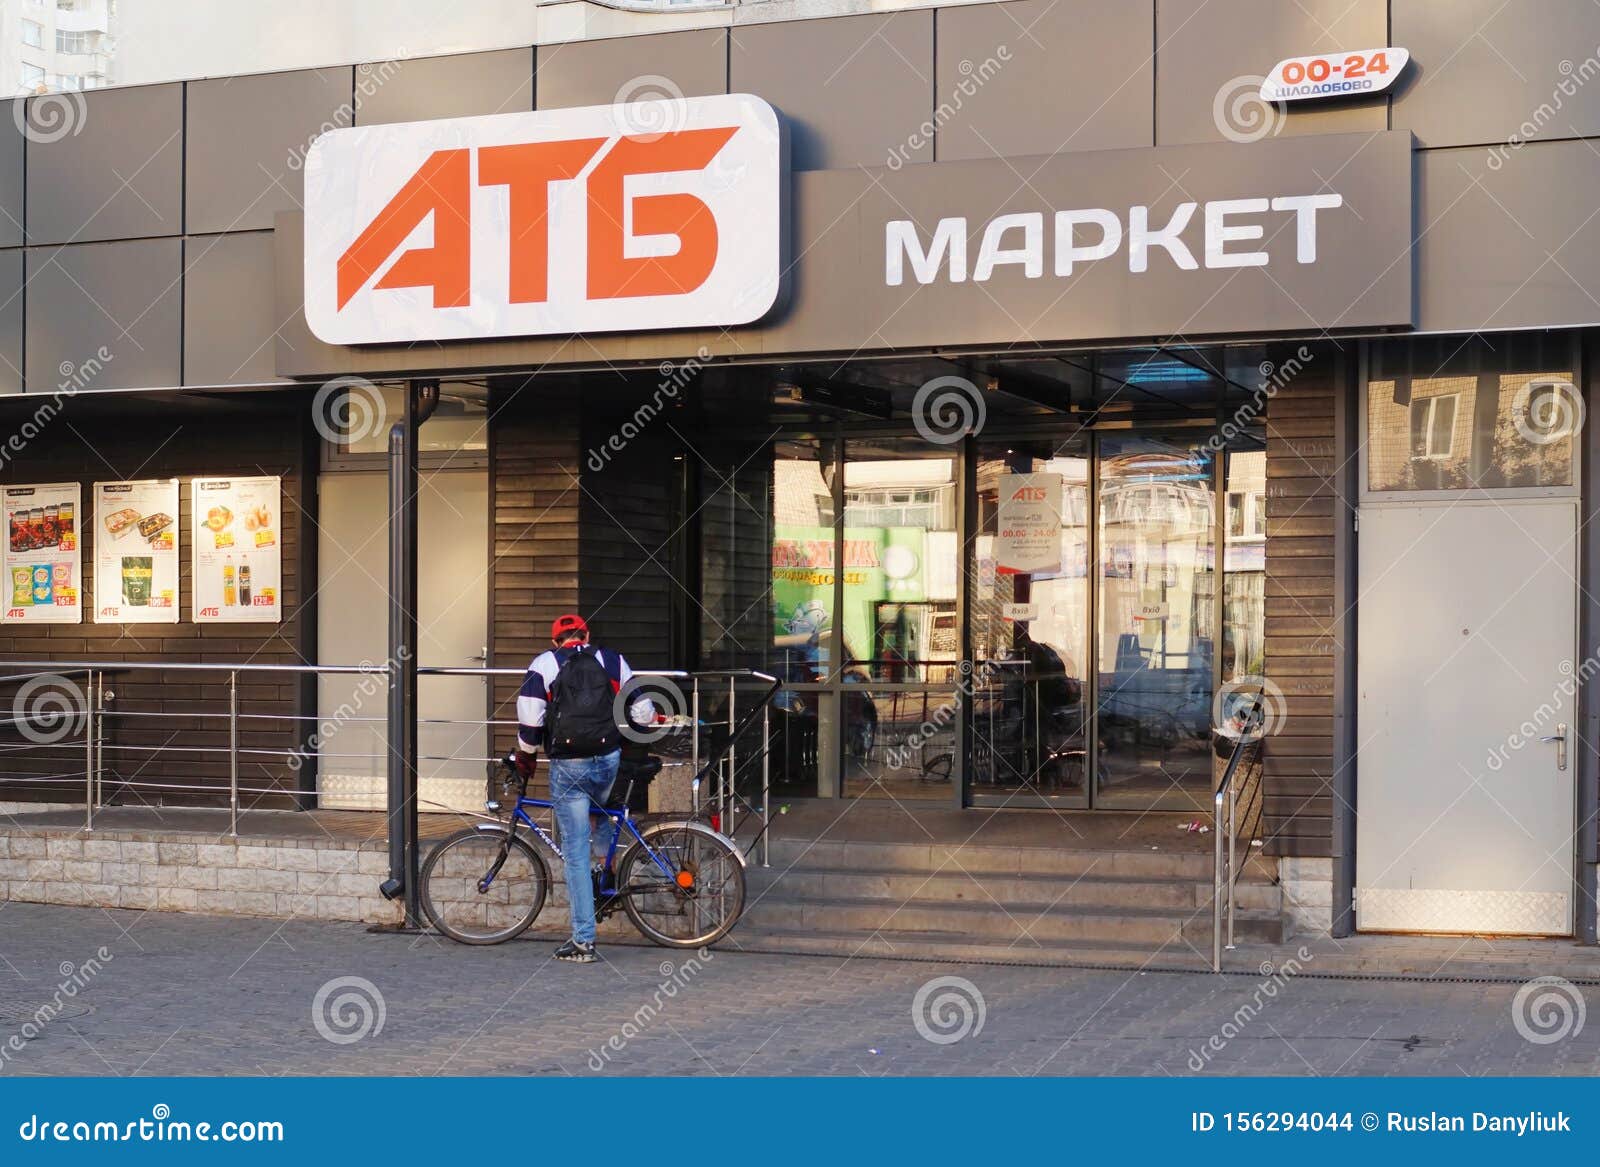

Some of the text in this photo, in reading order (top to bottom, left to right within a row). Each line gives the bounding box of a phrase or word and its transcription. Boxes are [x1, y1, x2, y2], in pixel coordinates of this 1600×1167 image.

[1282, 53, 1389, 85] 00-24
[1275, 79, 1373, 98] ЦІЛОДОБОВО
[337, 126, 741, 313] АТБ
[885, 193, 1342, 287] МАРКЕТ
[1012, 486, 1048, 501] АТБ
